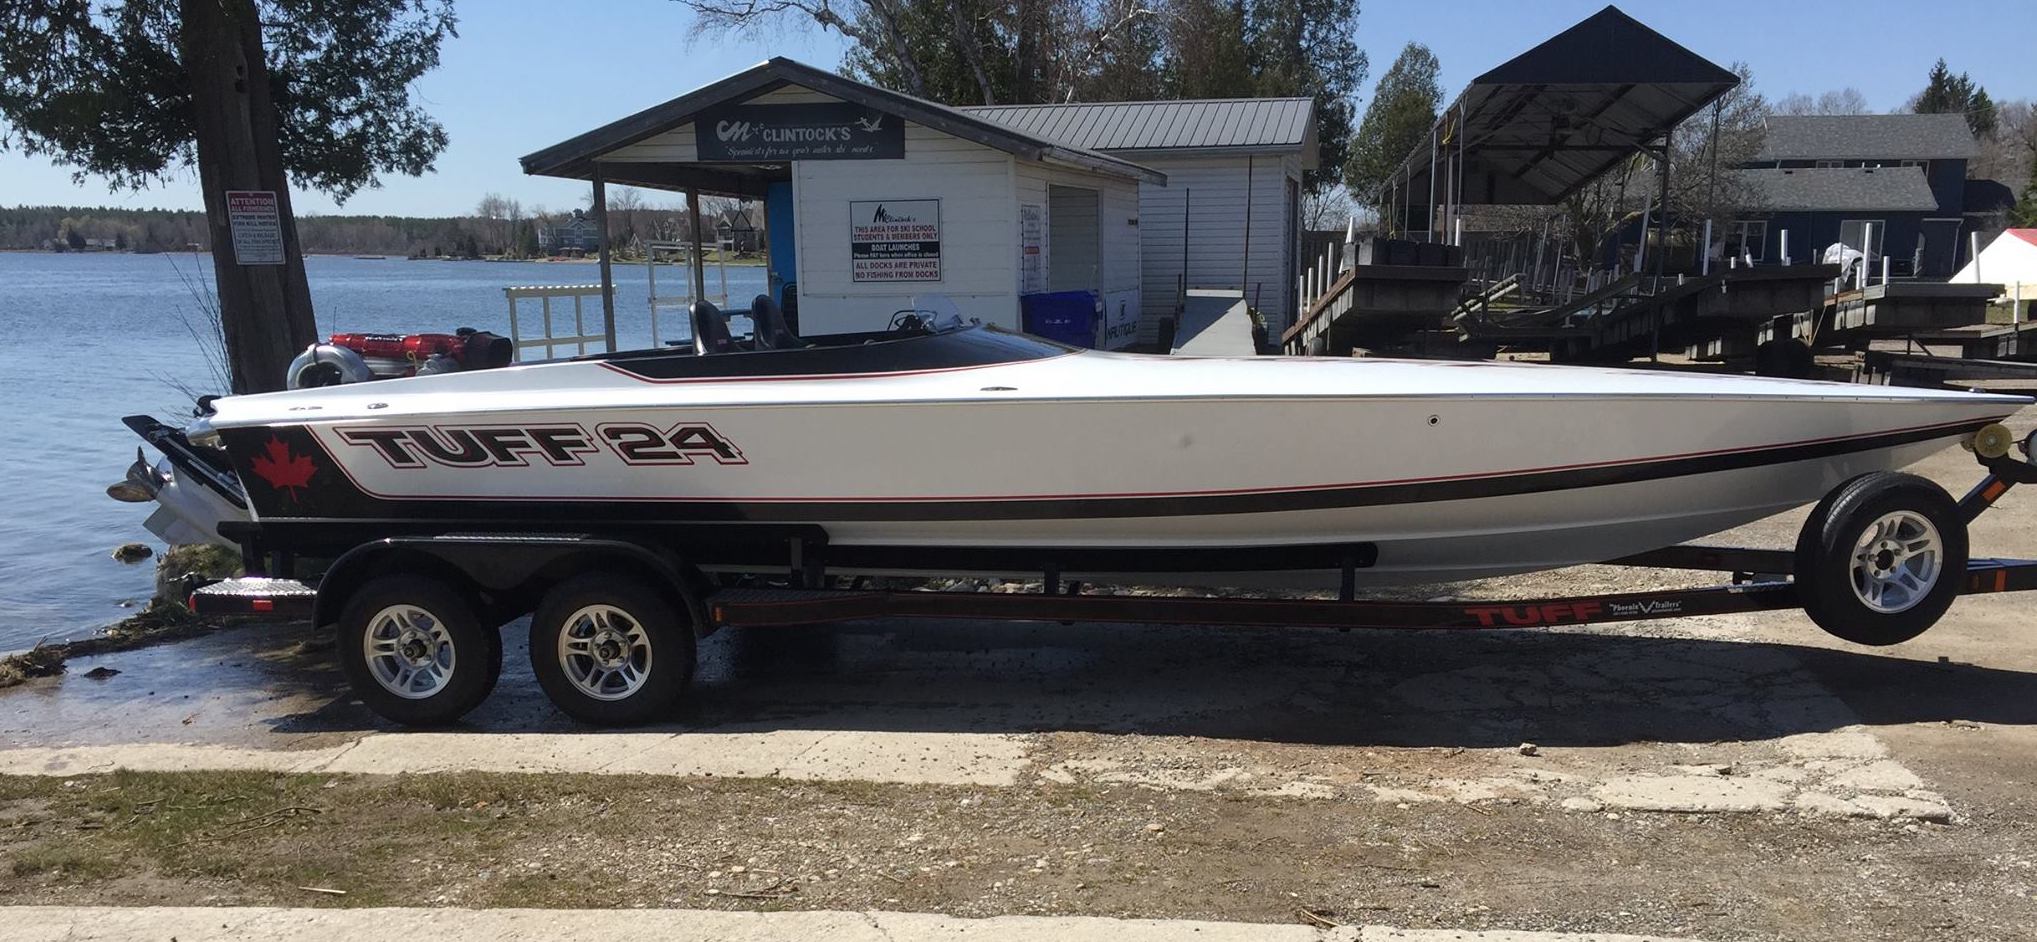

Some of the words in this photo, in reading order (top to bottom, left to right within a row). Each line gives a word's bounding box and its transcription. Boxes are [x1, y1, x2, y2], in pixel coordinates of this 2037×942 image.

[230, 198, 274, 206] ATTENTION
[887, 225, 899, 233] FOR
[912, 224, 936, 232] SCHOOL
[854, 233, 884, 241] STUDENTS
[921, 232, 937, 240] ONLY
[888, 243, 920, 251] LAUNCHES
[867, 271, 893, 279] FISHING
[333, 425, 600, 469] TUFF
[596, 422, 749, 466] 24
[1465, 602, 1602, 627] TUFF
